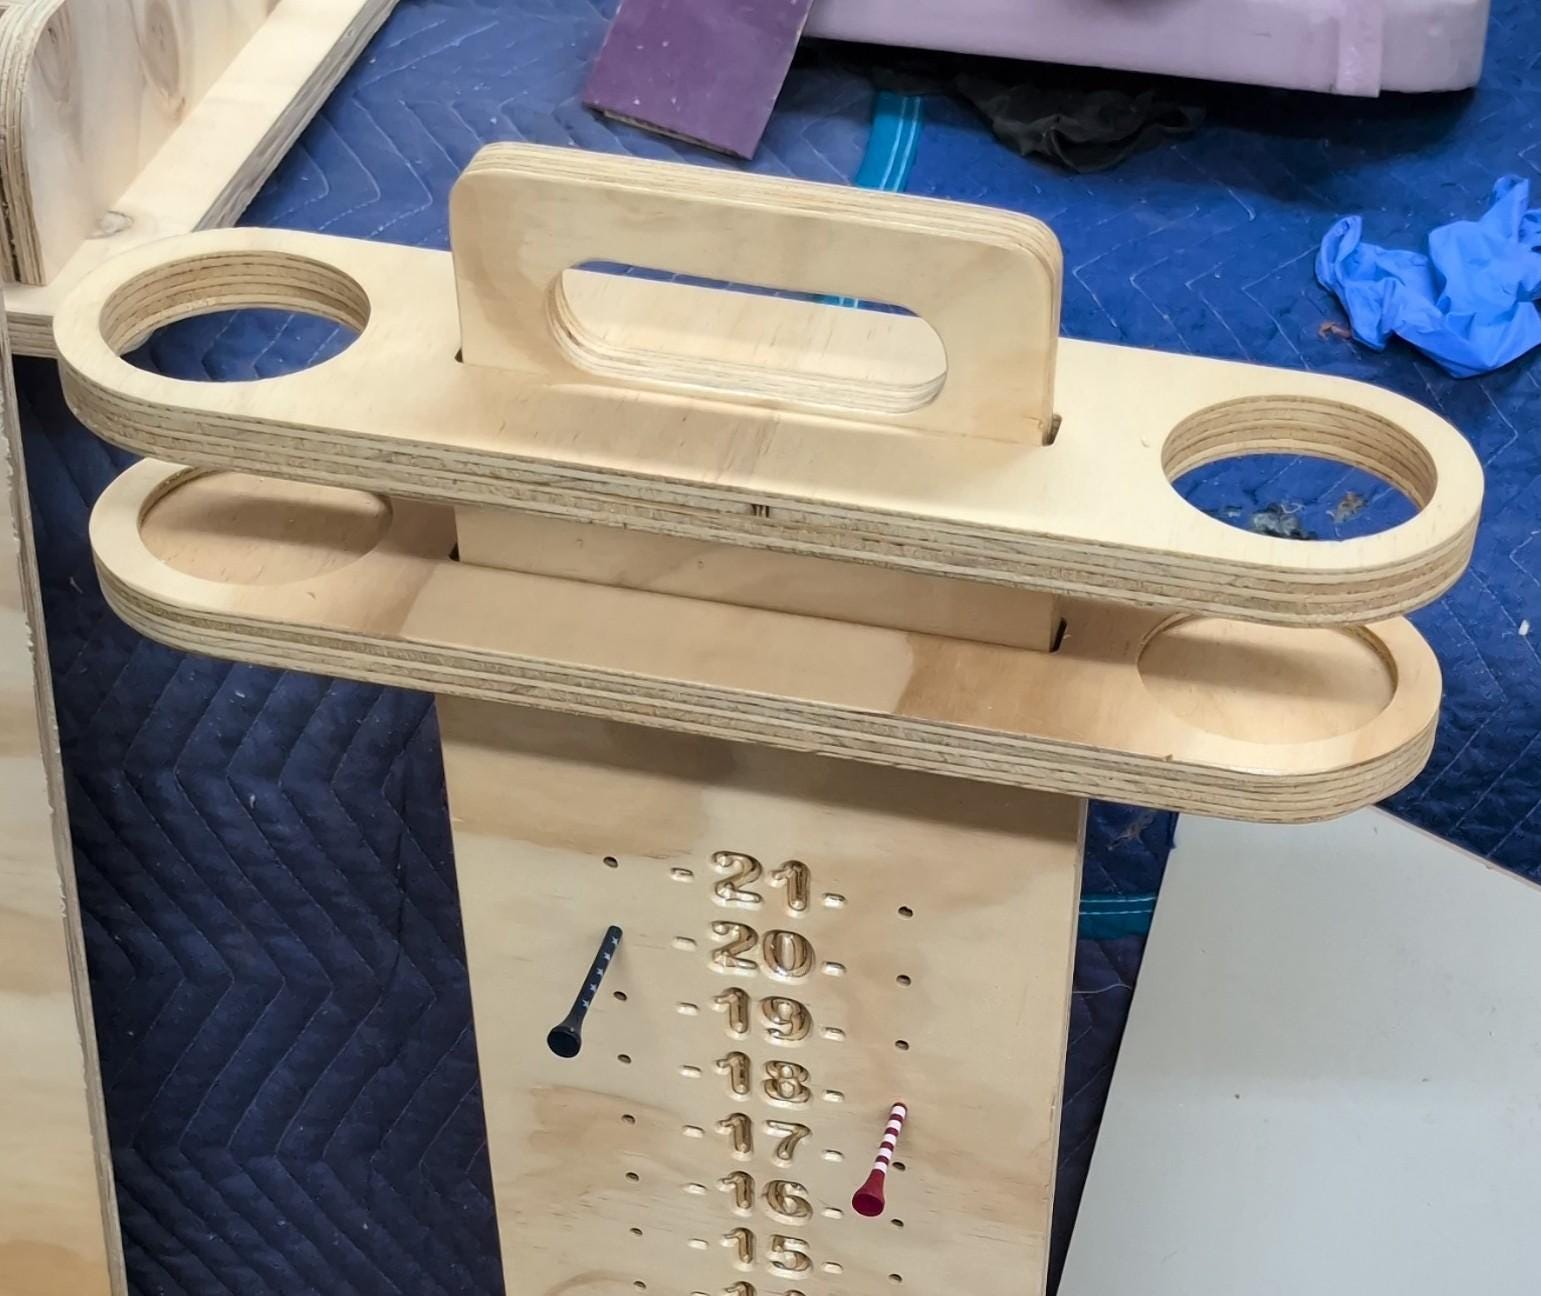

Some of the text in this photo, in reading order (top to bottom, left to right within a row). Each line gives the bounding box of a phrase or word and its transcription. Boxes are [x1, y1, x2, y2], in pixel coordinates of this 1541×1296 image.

[711, 851, 811, 913] 21
[709, 920, 815, 980] 20
[712, 987, 812, 1043] 19
[715, 1051, 811, 1105] 18
[716, 1112, 811, 1164] 17
[717, 1171, 813, 1221] 16
[721, 1227, 813, 1276] 15
